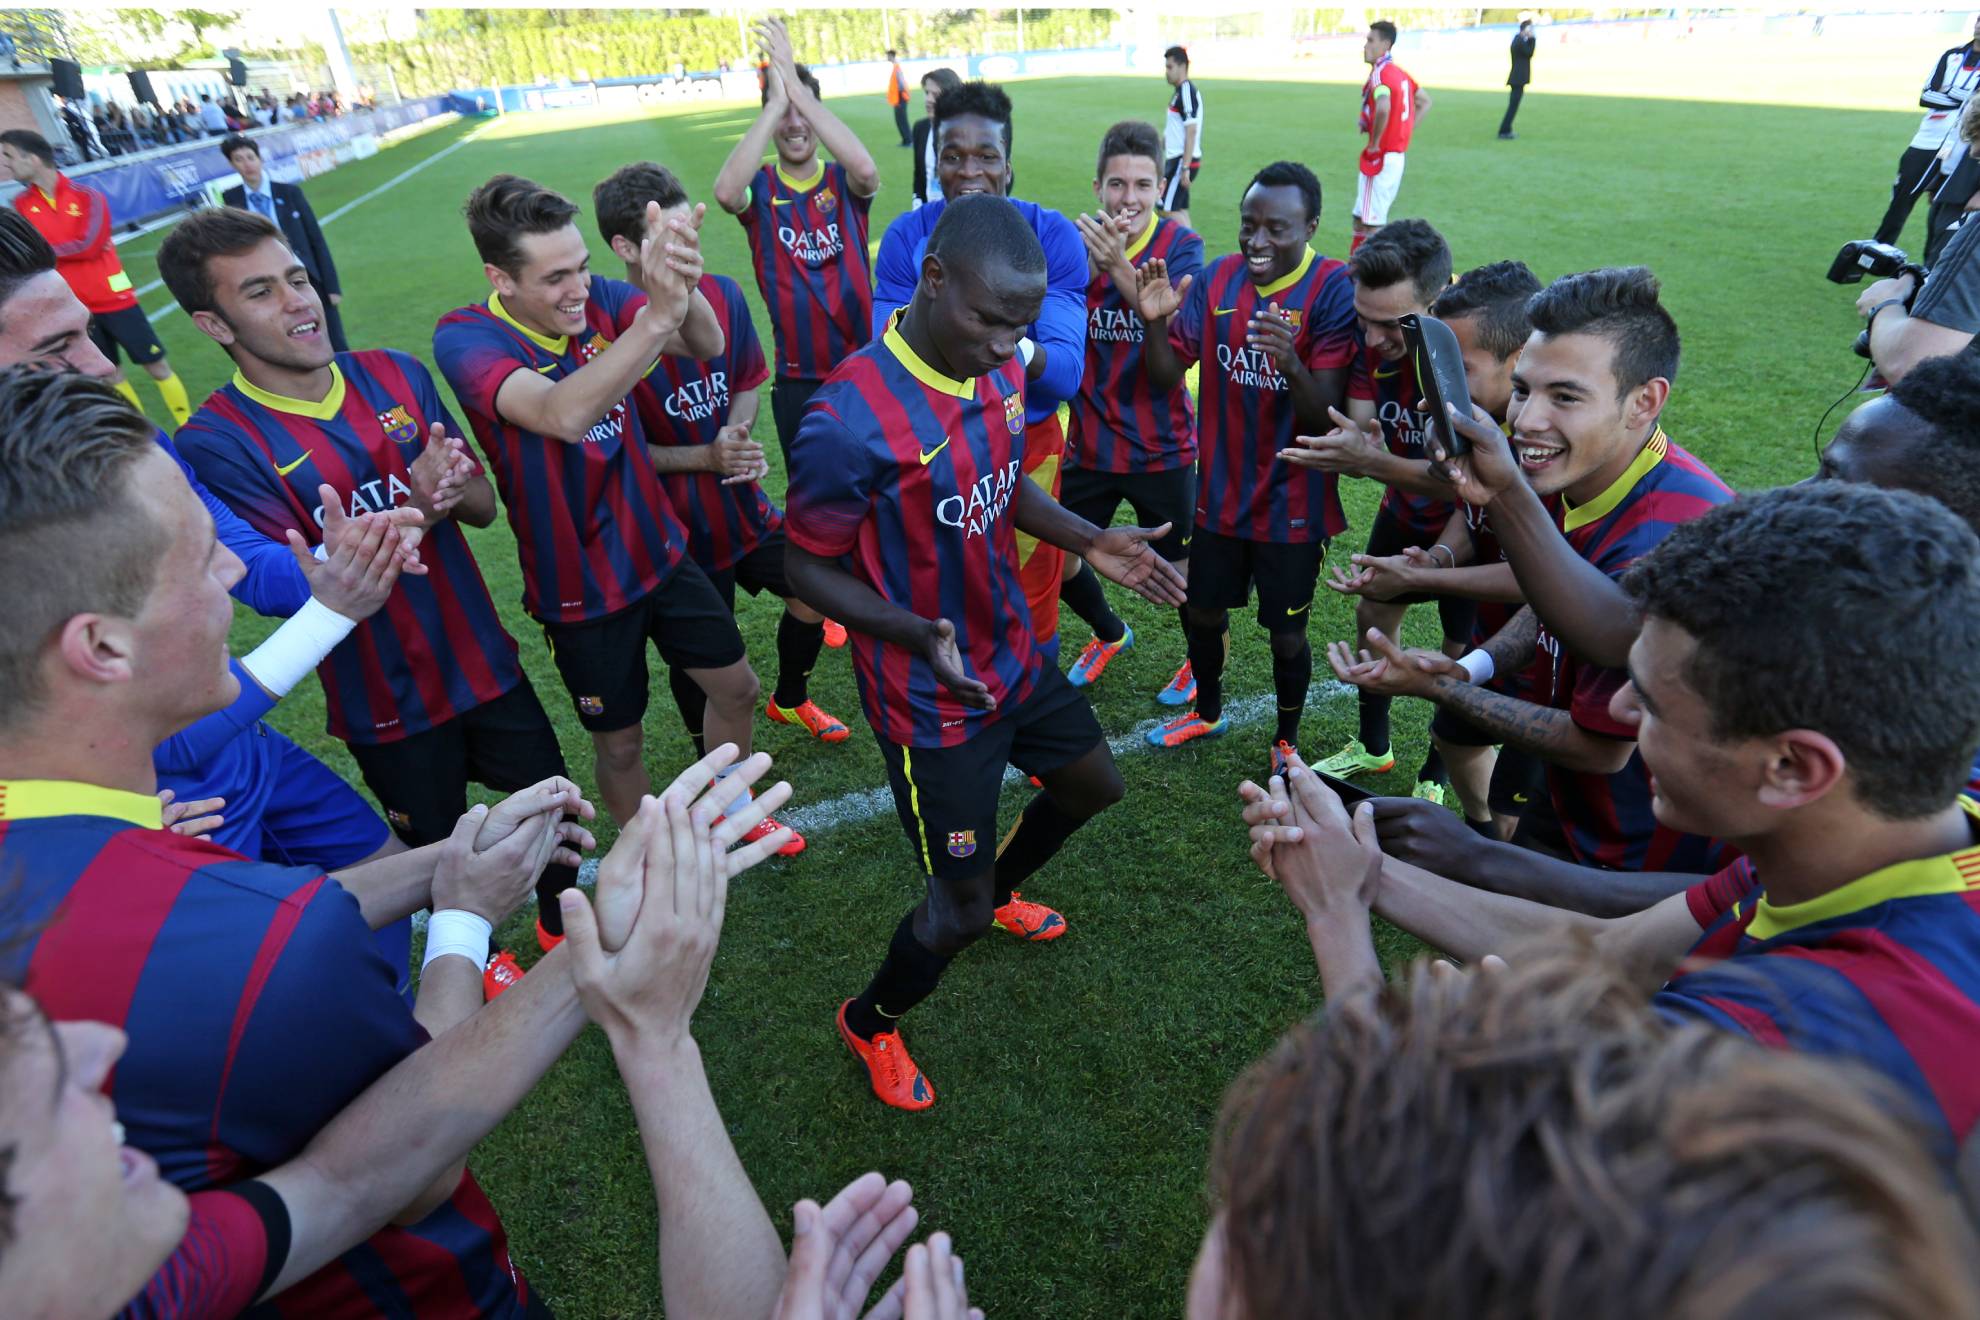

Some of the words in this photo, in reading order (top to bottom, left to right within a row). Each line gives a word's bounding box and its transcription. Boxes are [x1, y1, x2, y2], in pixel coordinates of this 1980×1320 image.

[778, 223, 840, 250] QATAR
[793, 239, 844, 261] AIRWAYS
[1089, 306, 1144, 330] ATAR
[1216, 343, 1280, 376] QATA
[1379, 400, 1431, 431] QAT
[312, 467, 412, 529] ATA
[936, 459, 1020, 529] QATAR
